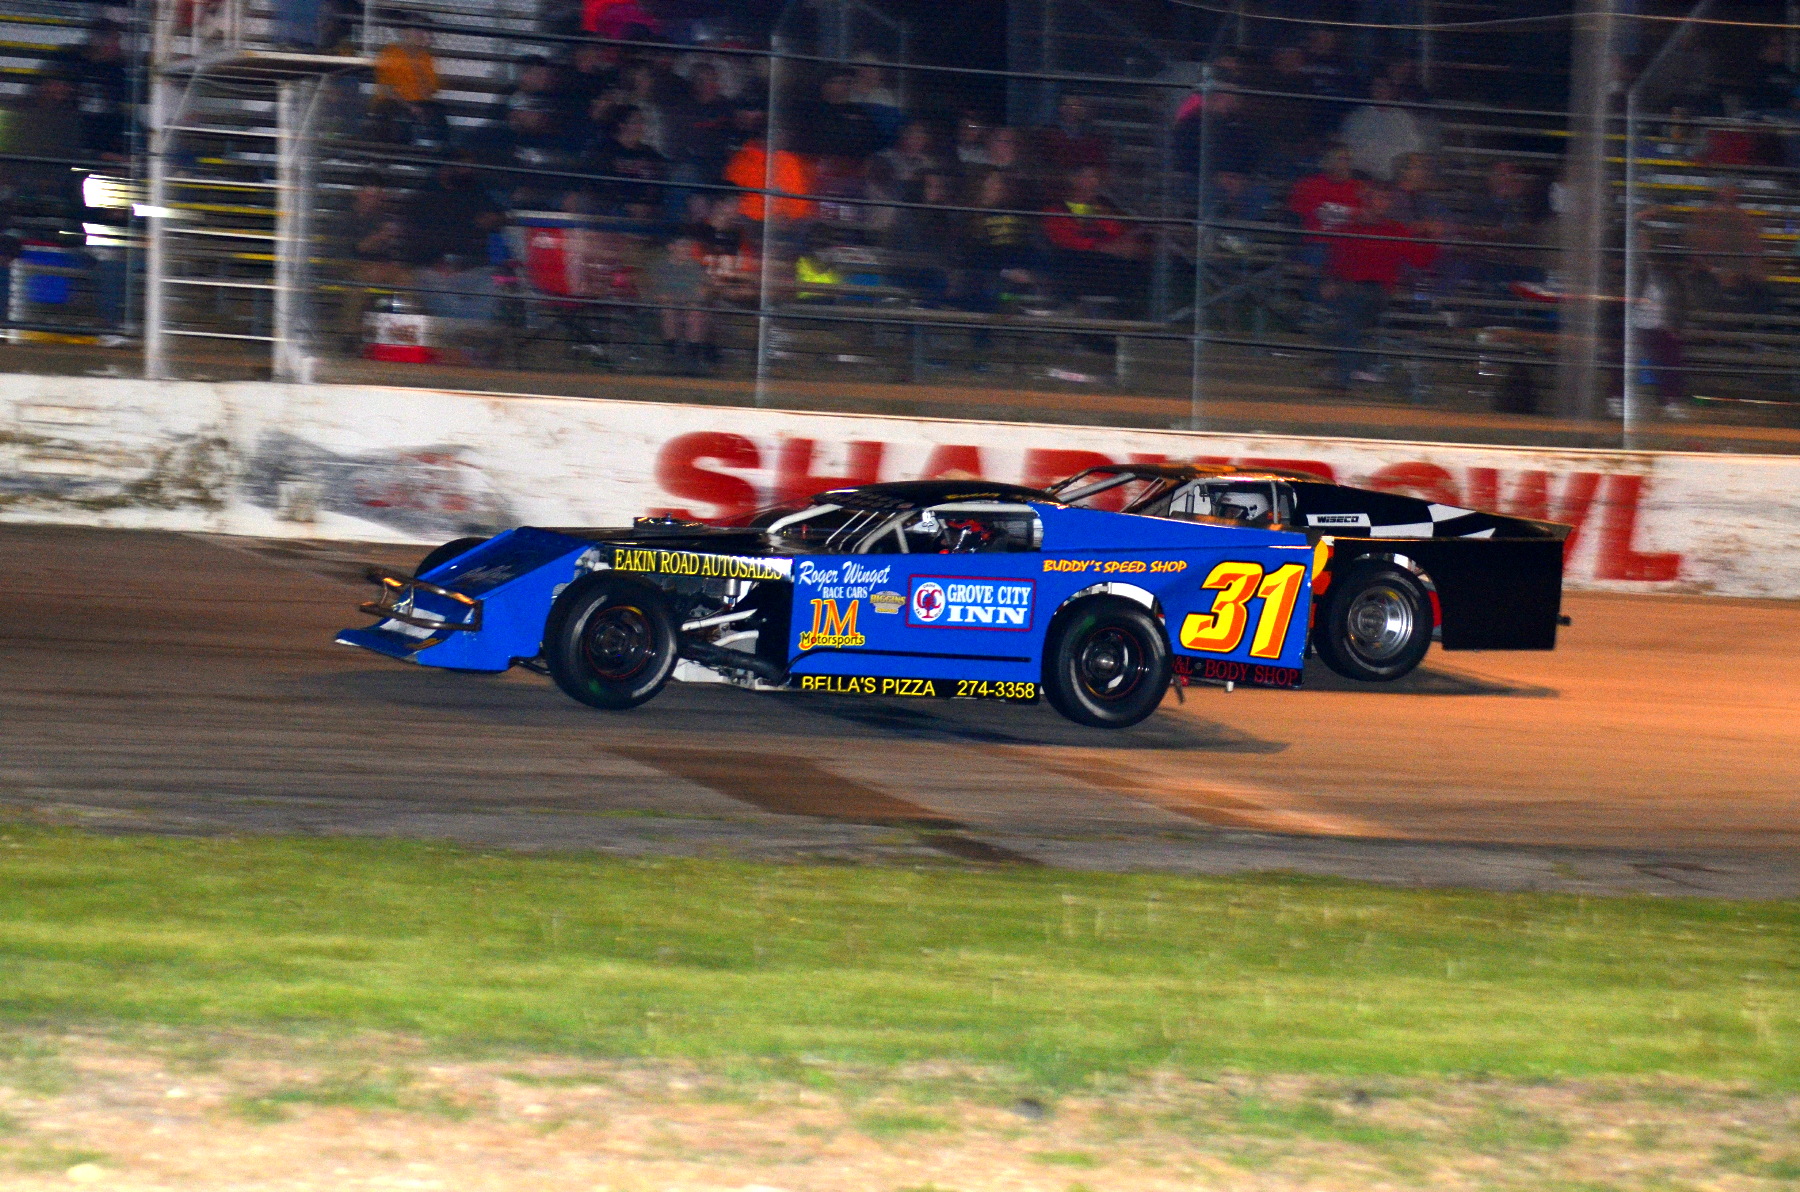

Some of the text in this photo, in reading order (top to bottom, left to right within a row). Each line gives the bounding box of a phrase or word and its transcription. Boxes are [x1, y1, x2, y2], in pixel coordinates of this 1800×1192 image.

[614, 549, 783, 580] EAKIN ROAD AUTOSALES
[1103, 560, 1147, 573] SPEED
[1150, 560, 1188, 573] SHOP
[798, 561, 891, 592] Roger Winget
[822, 586, 868, 599] RACE CARS
[947, 584, 1031, 605] GROVE CITY
[946, 605, 1028, 625] INN
[1179, 561, 1306, 660] 31
[800, 631, 865, 648] Motorsports
[1205, 659, 1250, 682] BODY
[1254, 665, 1299, 686] SHOP
[801, 675, 1035, 699] BELLA'S PIZZA 274-3358
